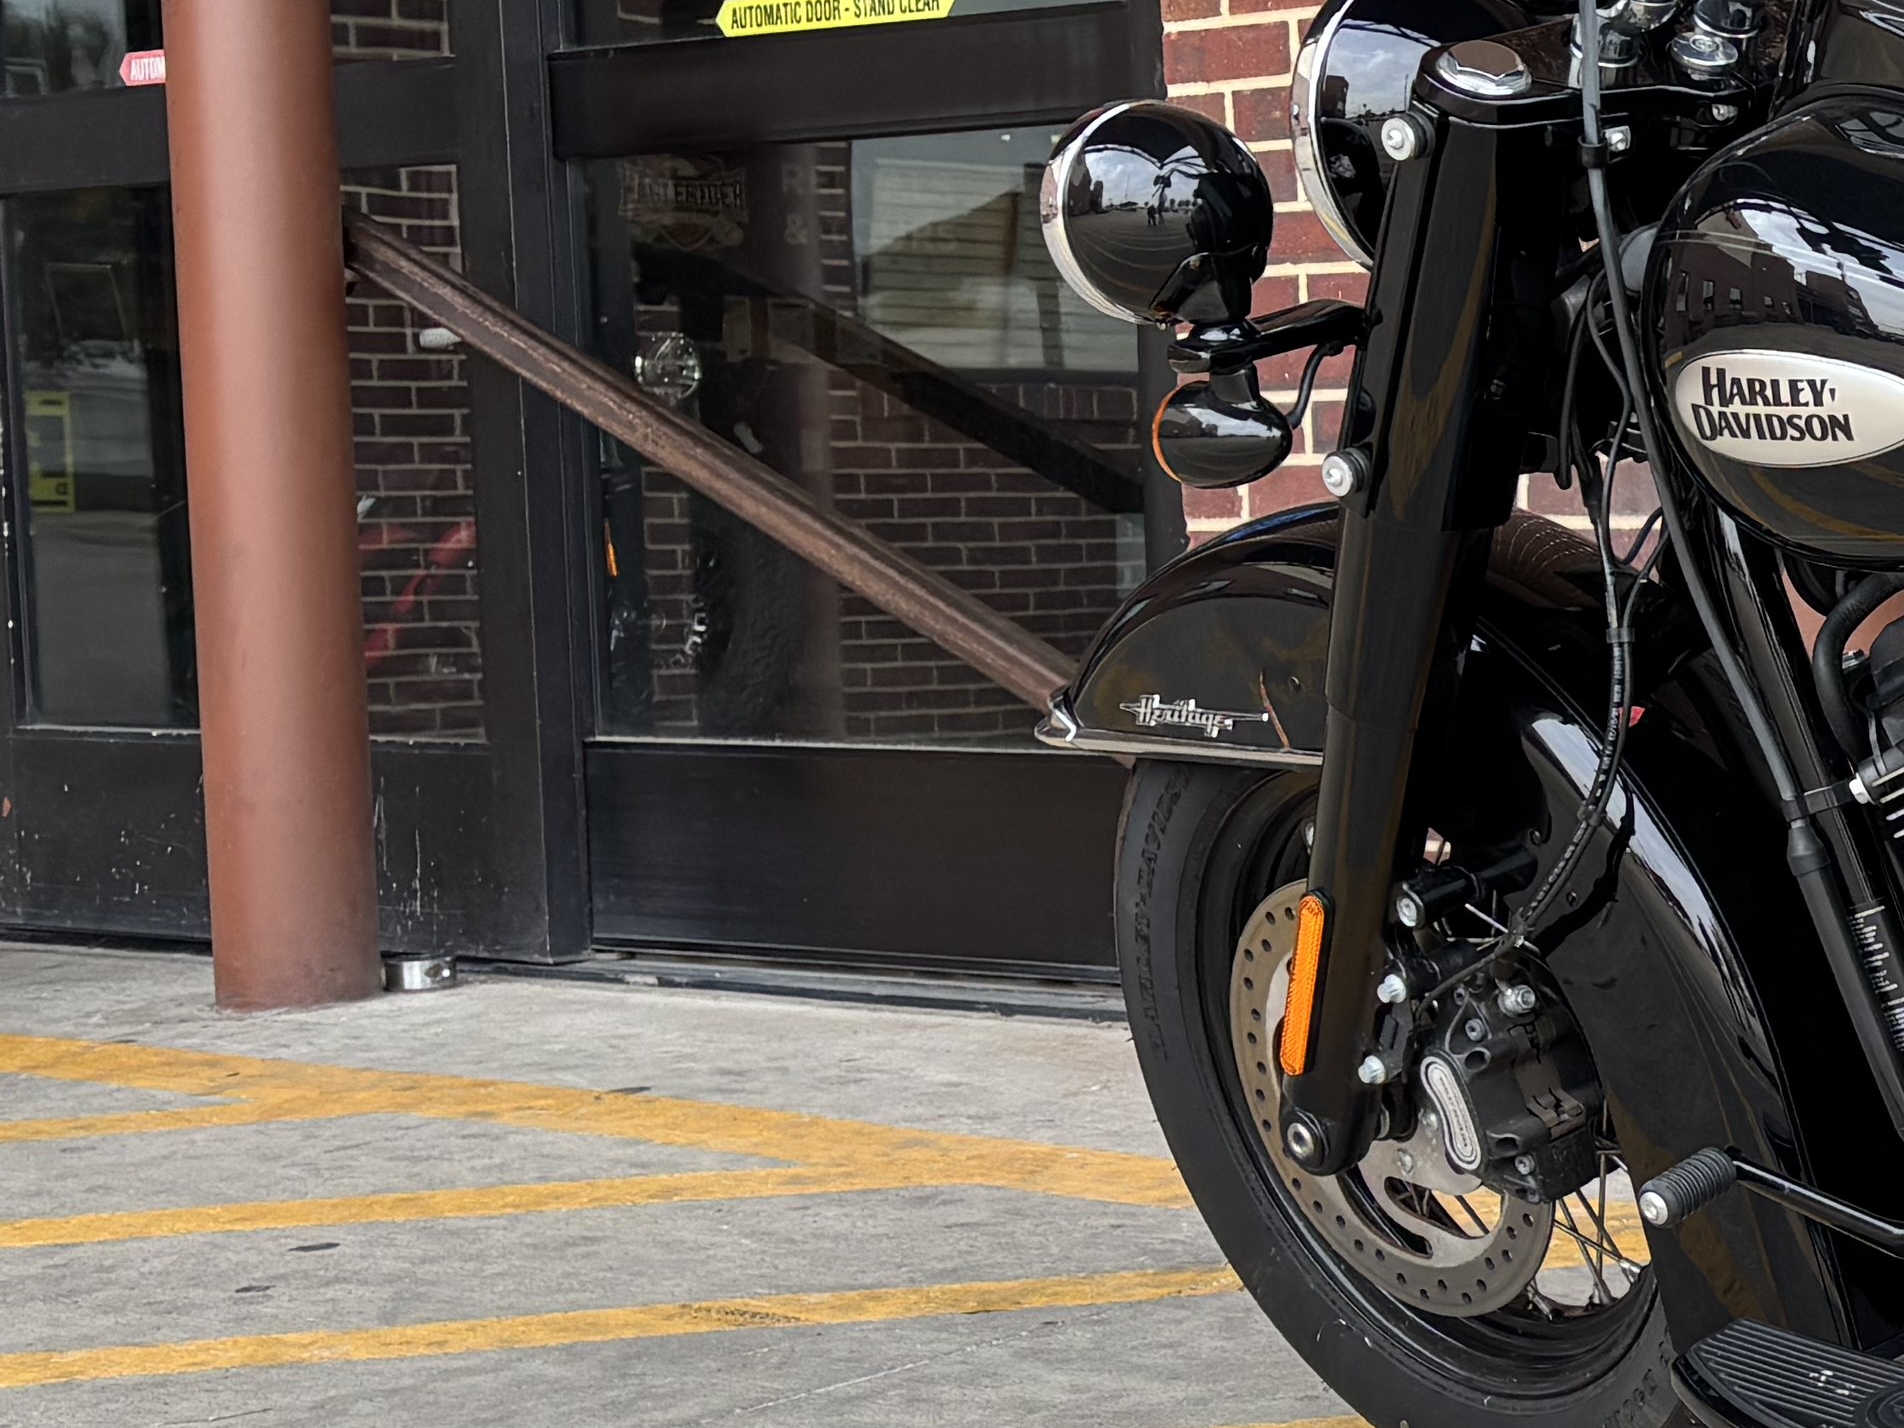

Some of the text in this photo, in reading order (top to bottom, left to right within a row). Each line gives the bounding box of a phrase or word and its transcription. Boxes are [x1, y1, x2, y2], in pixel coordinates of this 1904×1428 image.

[730, 1, 802, 30] AUTOMATIC
[1691, 403, 1854, 442] DAVIDSON
[1136, 694, 1234, 739] Heritage
